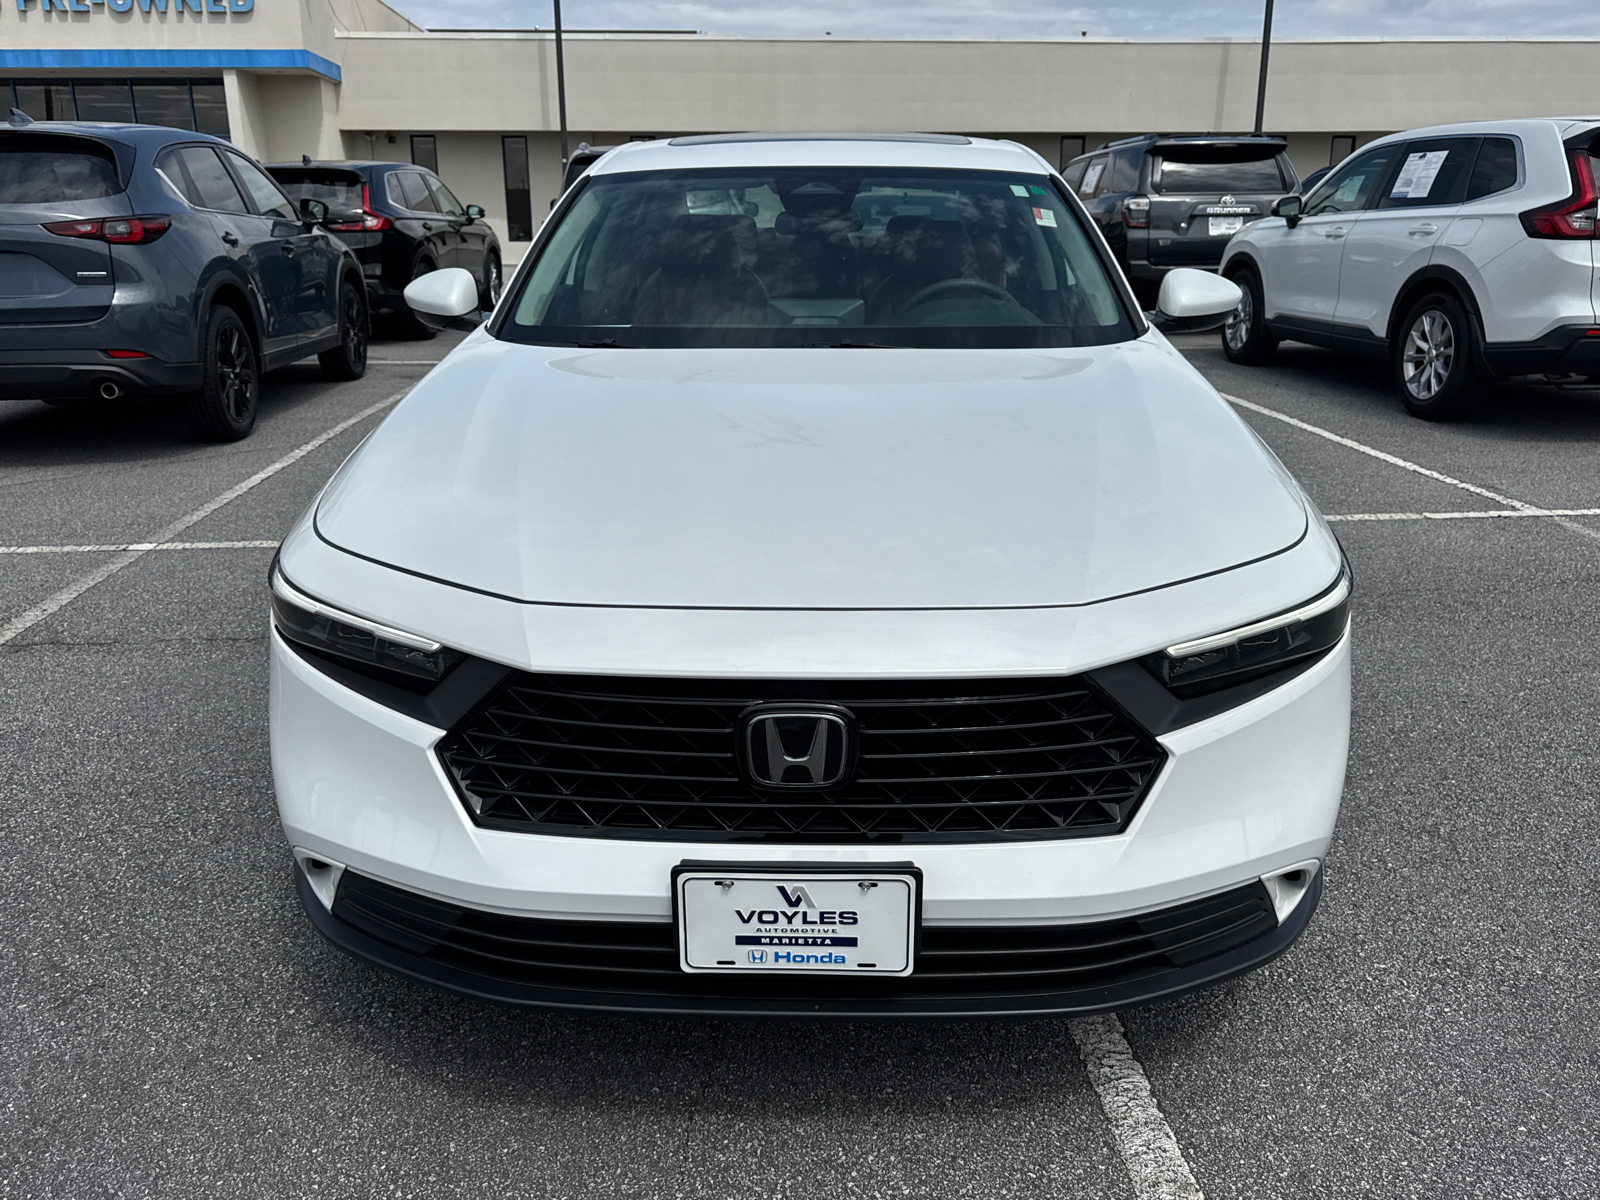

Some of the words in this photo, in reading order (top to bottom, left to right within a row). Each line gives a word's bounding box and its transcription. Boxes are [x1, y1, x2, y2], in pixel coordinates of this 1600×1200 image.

[735, 910, 858, 925] VOYLES
[761, 937, 832, 945] MARIETTA
[774, 951, 846, 964] Honda
